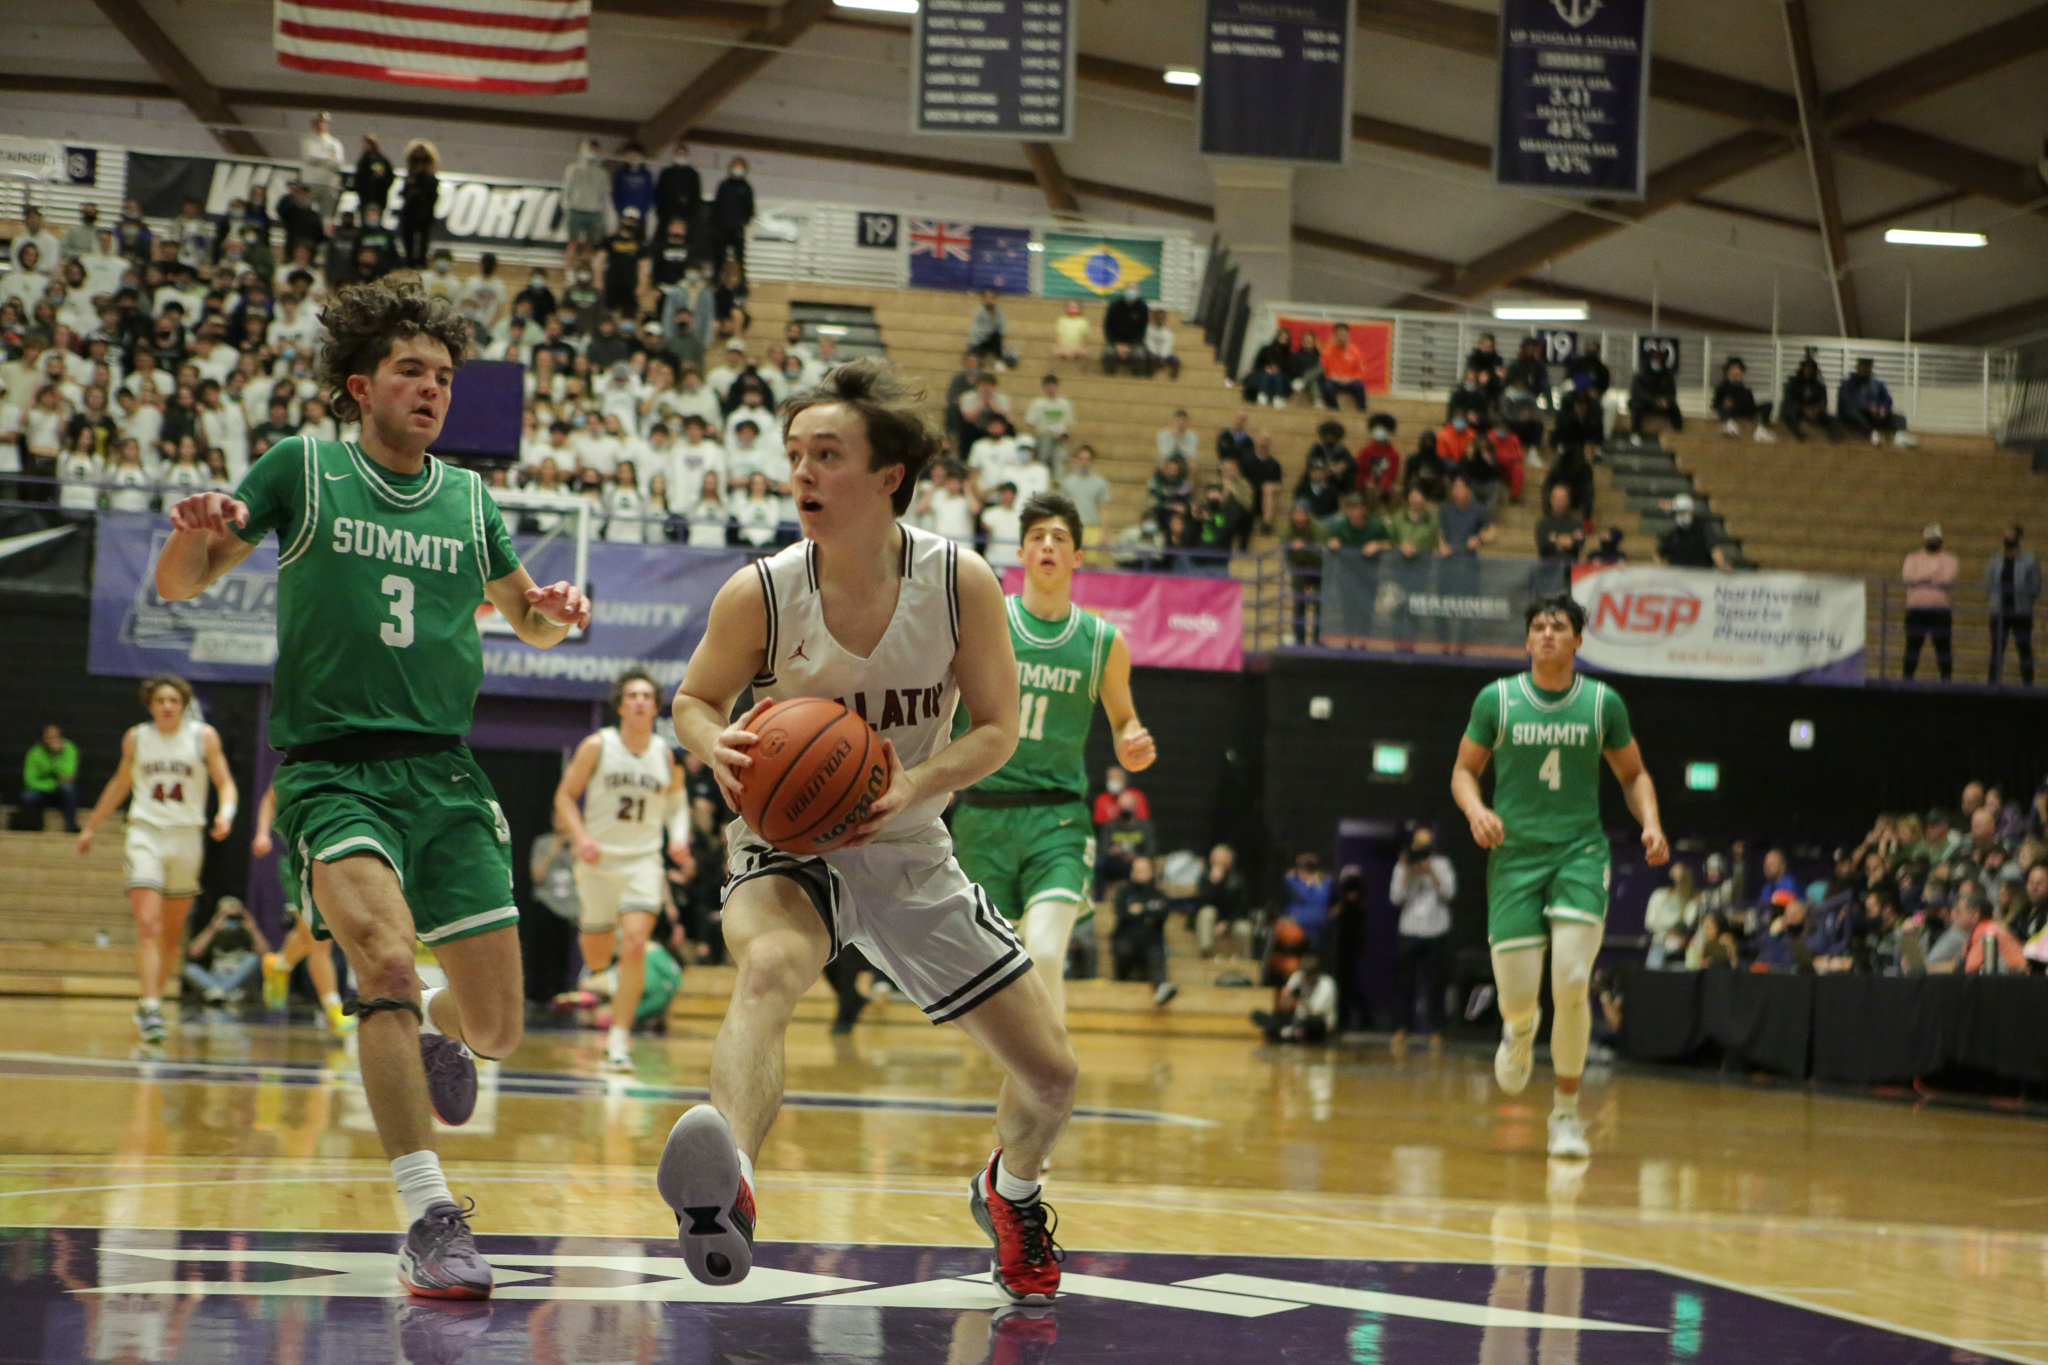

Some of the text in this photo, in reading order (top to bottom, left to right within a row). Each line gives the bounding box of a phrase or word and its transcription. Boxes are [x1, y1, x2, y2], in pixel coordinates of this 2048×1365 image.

[865, 216, 893, 245] 19
[1544, 331, 1574, 364] 19
[332, 516, 464, 575] SUMMIT
[380, 574, 415, 649] 3
[1713, 583, 1821, 608] Northwest
[595, 602, 691, 628] UNITY
[1594, 591, 1702, 636] NSP
[1713, 624, 1845, 651] Photography
[1016, 661, 1082, 693] MMIT
[834, 683, 944, 732] LATIN
[1019, 692, 1048, 740] 11
[1512, 722, 1590, 746] SUMMIT
[783, 738, 852, 822] EVOLUTION
[1539, 748, 1561, 791] 4
[151, 783, 184, 803] 44
[616, 796, 646, 821] 21
